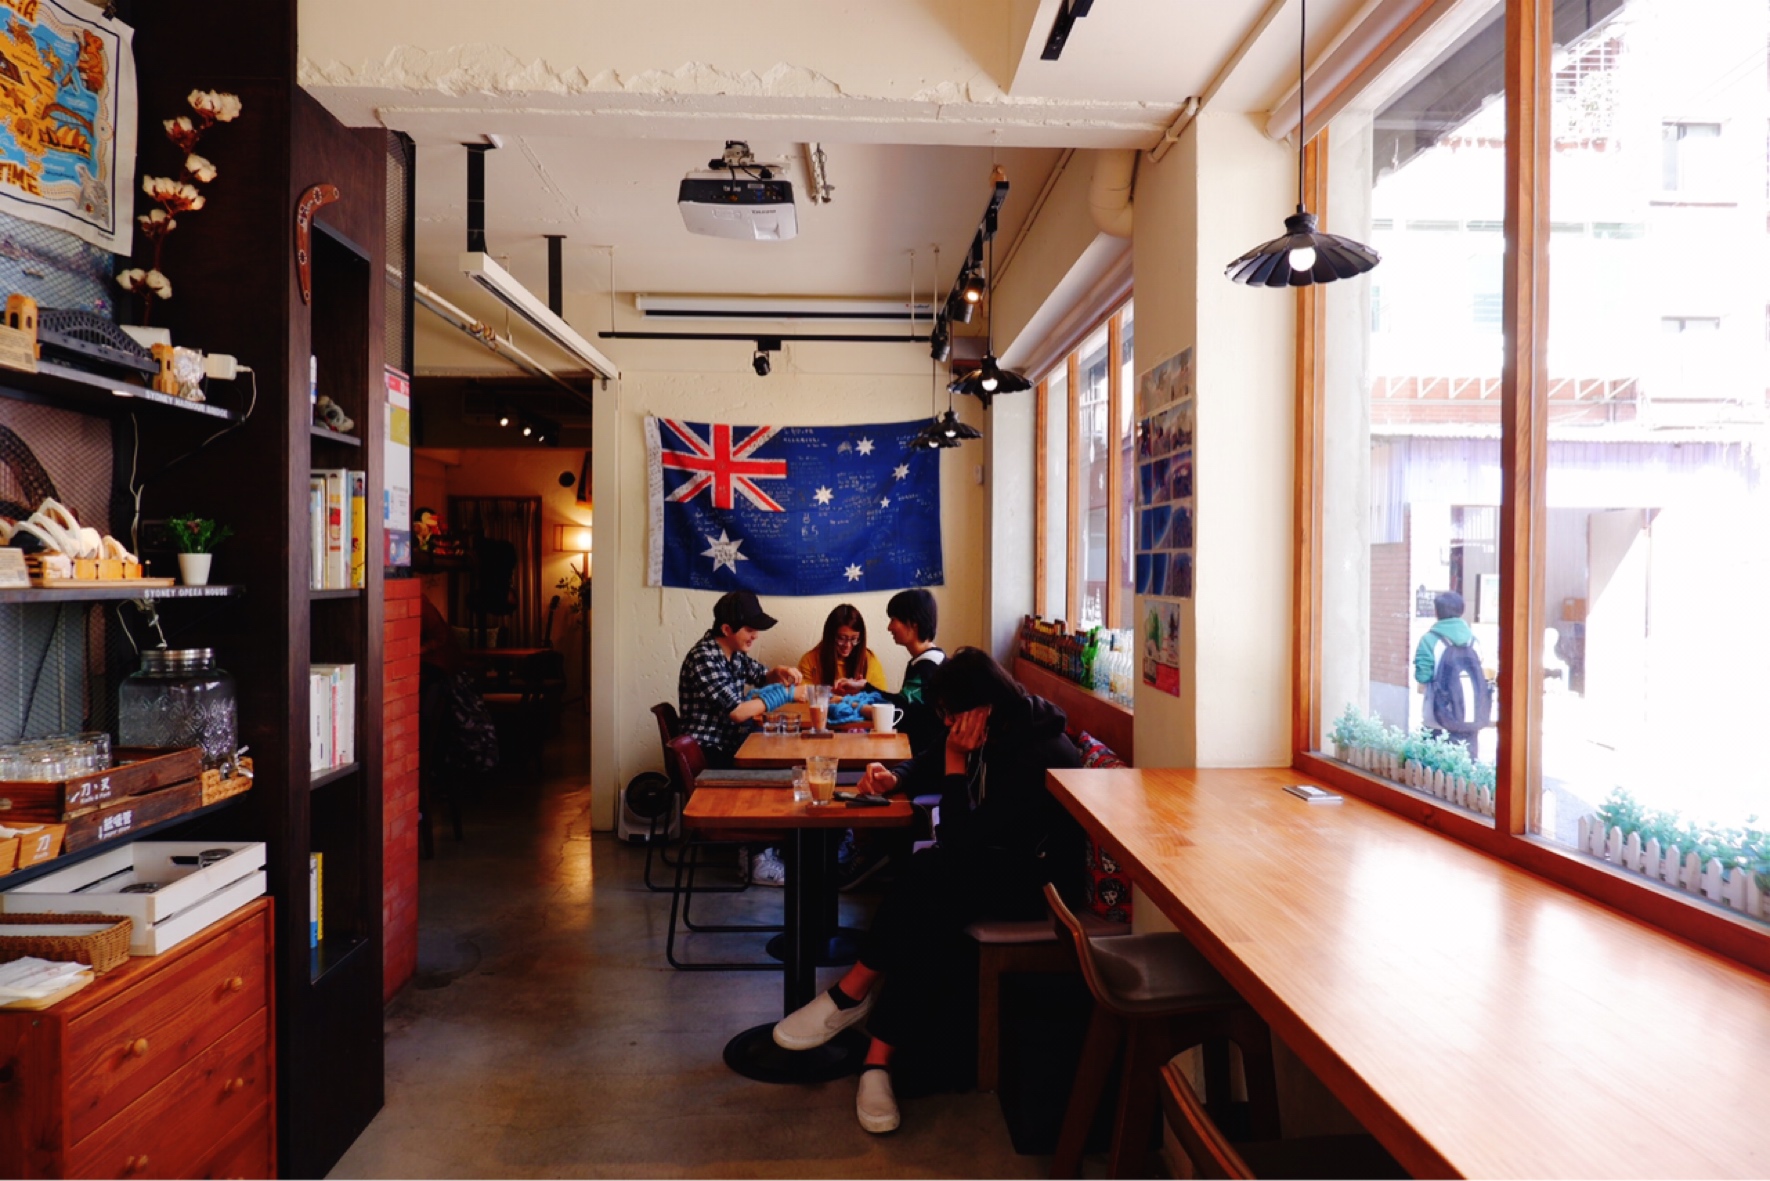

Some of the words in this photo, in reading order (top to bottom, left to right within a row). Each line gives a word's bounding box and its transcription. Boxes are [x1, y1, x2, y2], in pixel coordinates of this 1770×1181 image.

[145, 389, 175, 406] SYDNEY
[144, 588, 176, 598] SYDNEY
[178, 588, 203, 597] OPERA
[204, 587, 228, 597] HOUSE
[36, 834, 52, 852] 刀
